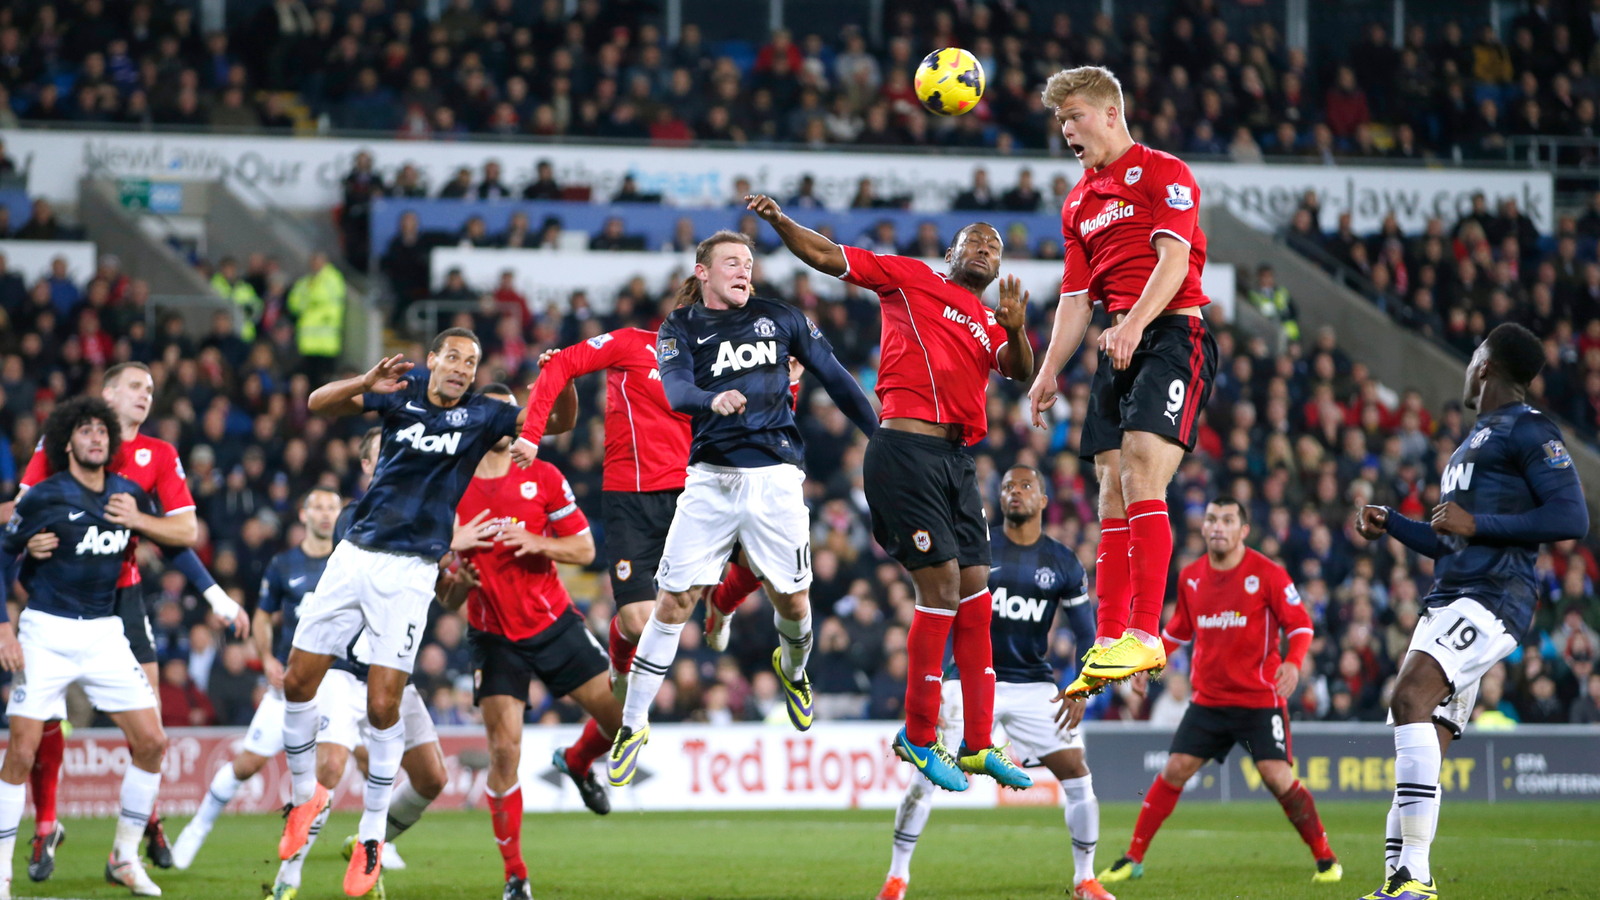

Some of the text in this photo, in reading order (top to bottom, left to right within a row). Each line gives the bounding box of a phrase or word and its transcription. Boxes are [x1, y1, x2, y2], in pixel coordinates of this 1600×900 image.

[237, 151, 303, 187] Our
[1080, 203, 1134, 237] Malaysia
[1105, 201, 1119, 212] visit
[711, 340, 777, 377] AON
[1166, 379, 1185, 412] 9
[396, 422, 462, 455] AON
[75, 525, 131, 555] AON
[991, 587, 1048, 622] AON
[404, 622, 417, 651] 5
[1197, 614, 1247, 631] Malaysia
[1444, 617, 1477, 651] 19
[1271, 714, 1285, 742] 8
[683, 737, 766, 793] Ted
[1240, 756, 1331, 793] VLE
[1338, 755, 1476, 793] RESRT
